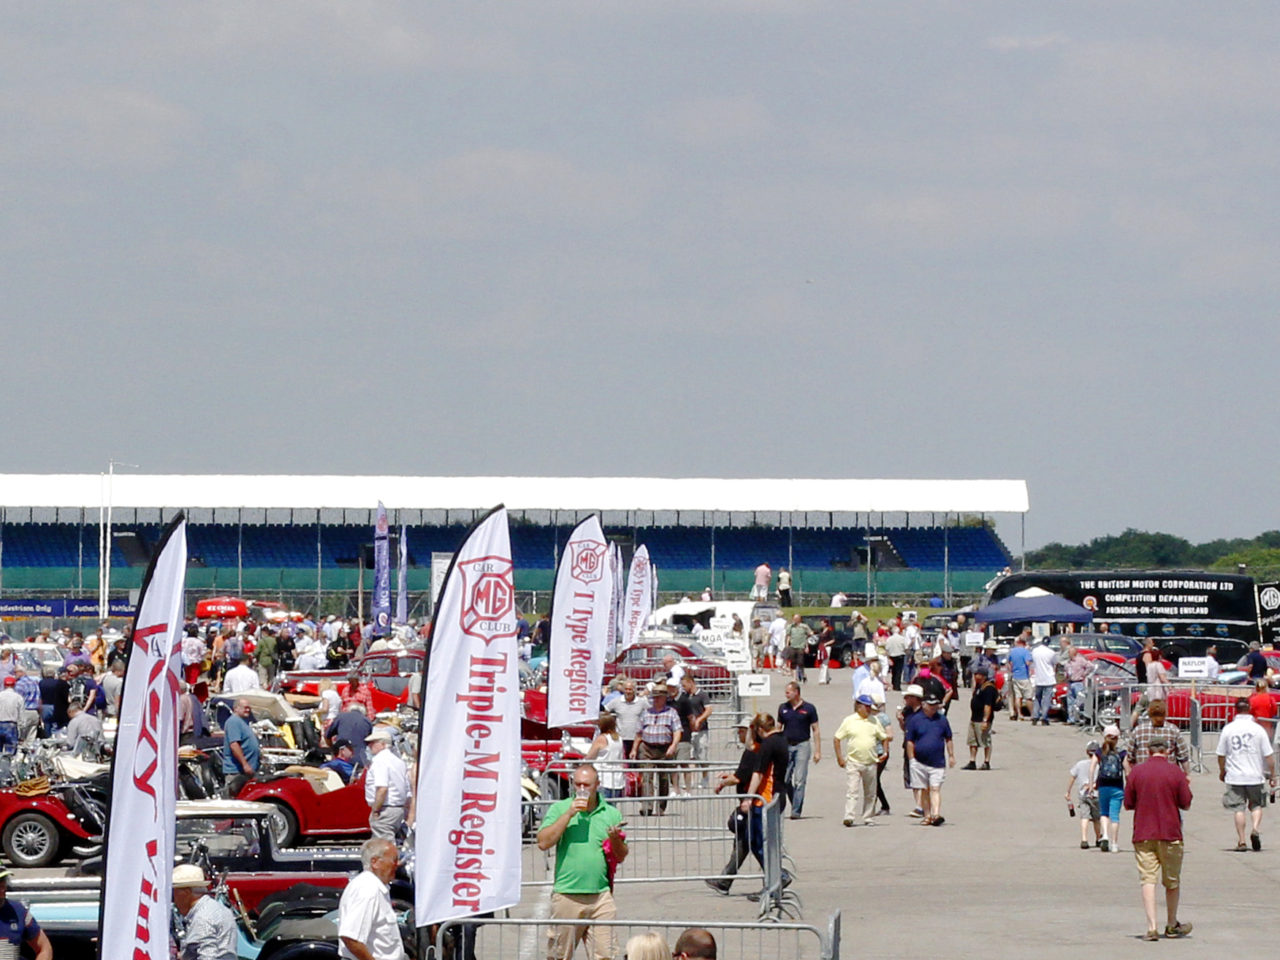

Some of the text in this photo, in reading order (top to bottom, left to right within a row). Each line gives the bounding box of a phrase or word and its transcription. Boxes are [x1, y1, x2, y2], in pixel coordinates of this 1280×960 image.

[580, 552, 595, 569] MG
[473, 562, 494, 573] CAR
[1080, 580, 1234, 591] THE BRITISH MOTOR CORPORATION LTD
[476, 579, 508, 615] MG
[1104, 594, 1209, 603] COMPETITION DEPARTMENT
[35, 604, 52, 614] Only
[1106, 606, 1209, 615] ABINGDON-ON-THAMES ENGLAND
[479, 621, 511, 633] CLUB
[702, 634, 723, 643] MGA
[563, 592, 595, 716] T Type Register
[448, 652, 508, 912] Triple-M Register
